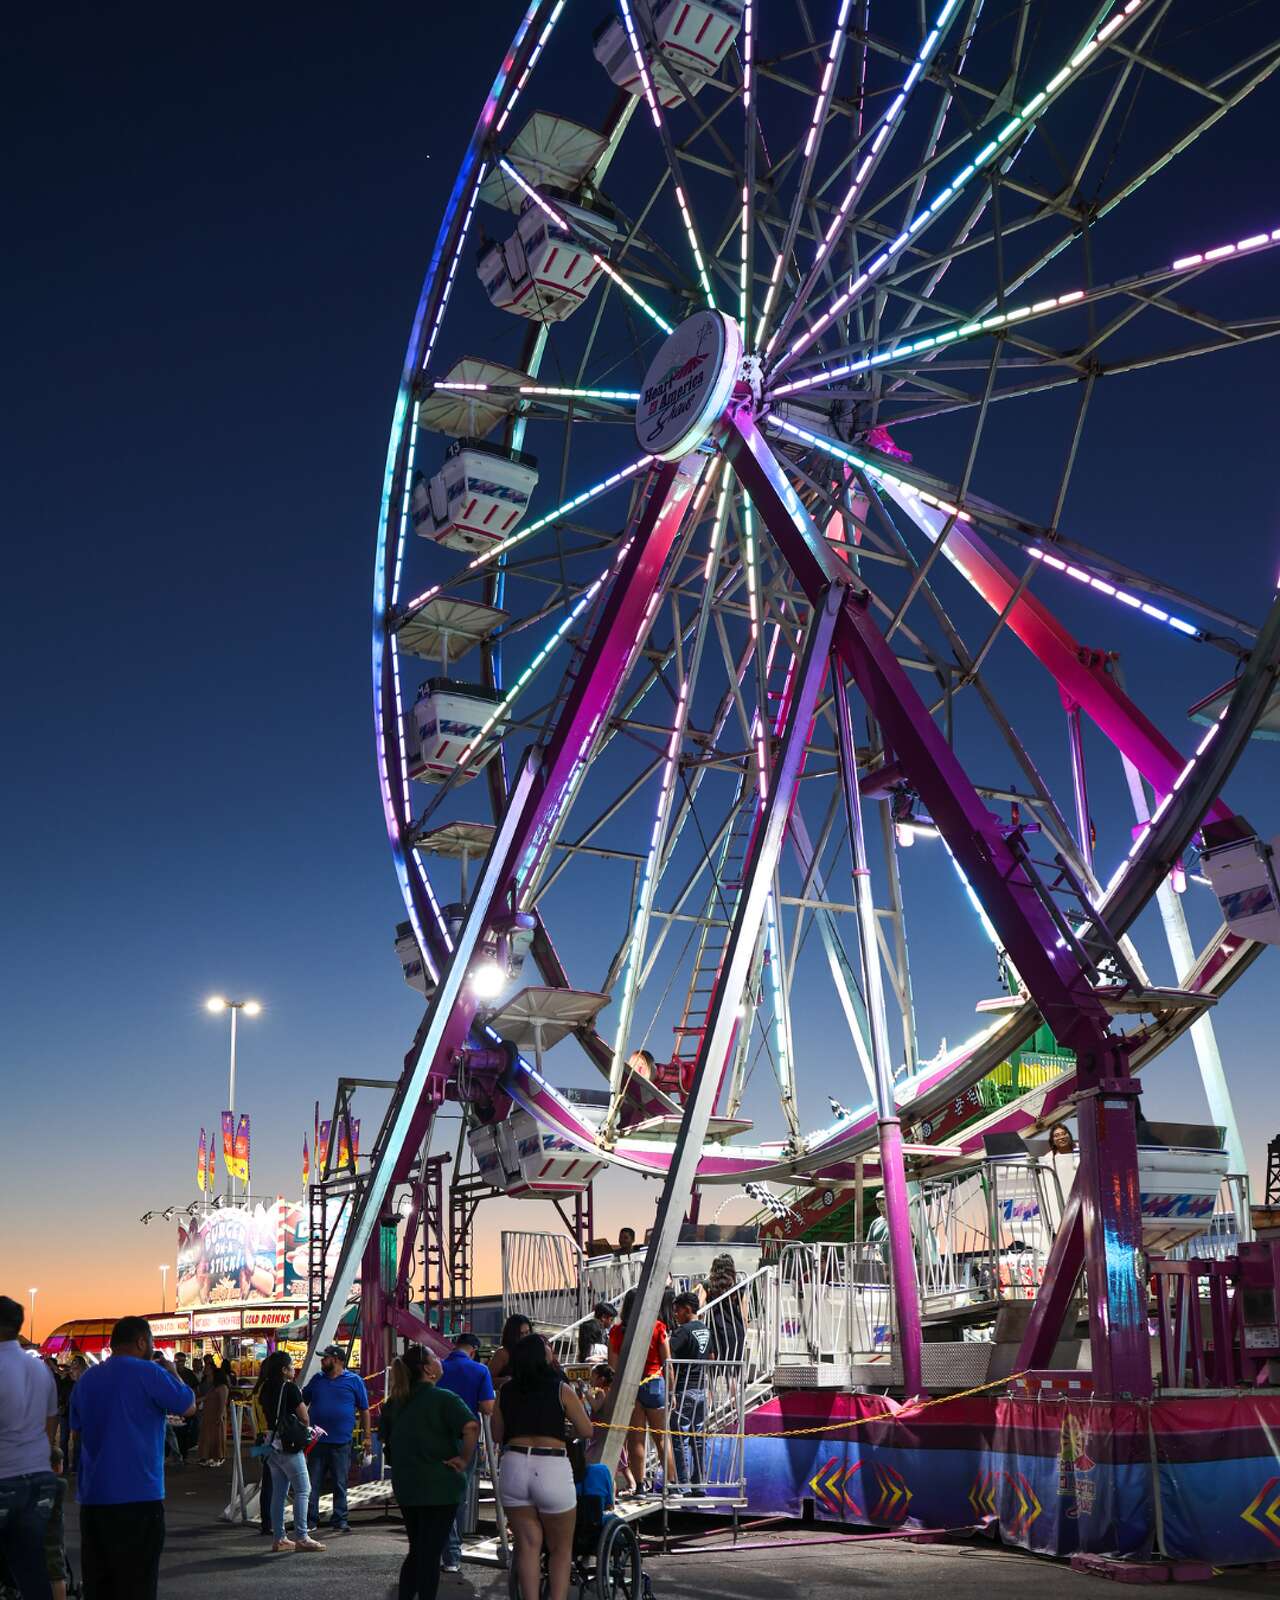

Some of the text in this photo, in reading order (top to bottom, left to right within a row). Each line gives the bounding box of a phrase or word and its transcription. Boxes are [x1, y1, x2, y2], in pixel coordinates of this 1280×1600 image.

[643, 377, 673, 405] Heart
[658, 370, 704, 410] America
[448, 441, 460, 456] 13
[417, 682, 431, 698] 14
[245, 1313, 291, 1324] COLD DRINKS
